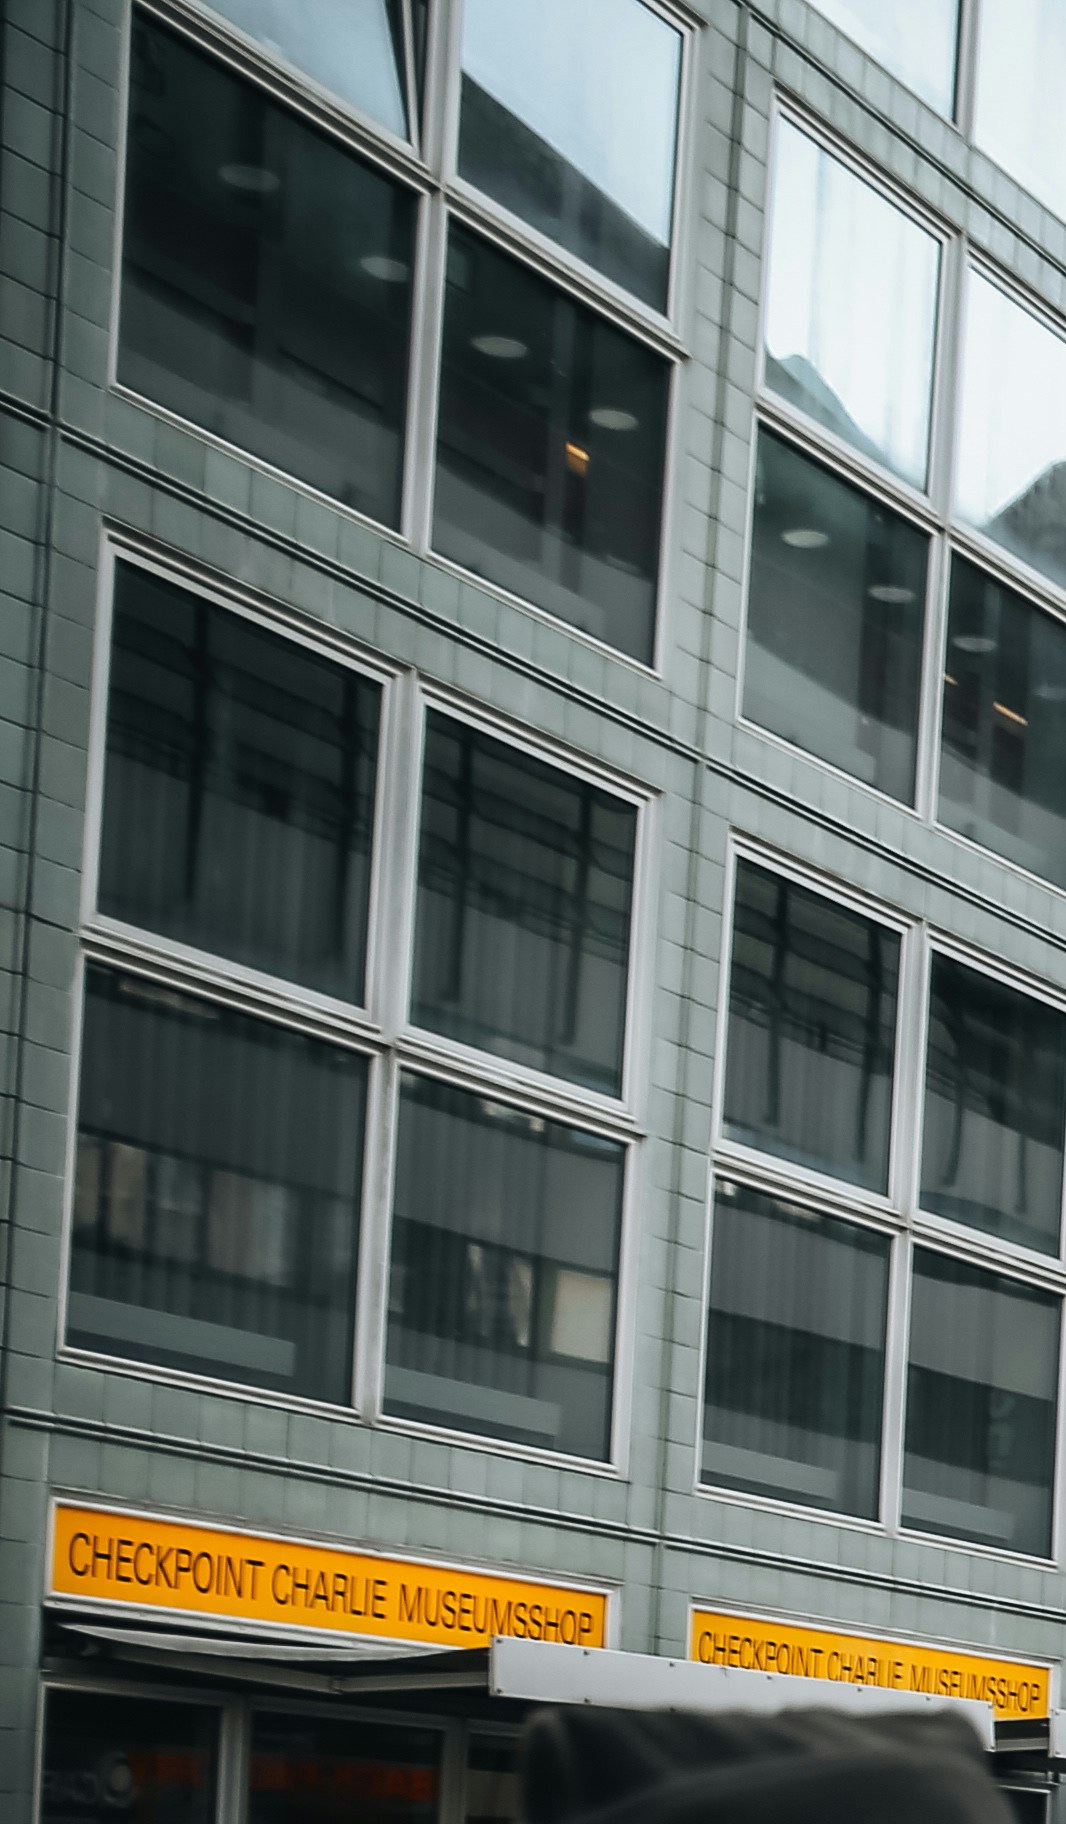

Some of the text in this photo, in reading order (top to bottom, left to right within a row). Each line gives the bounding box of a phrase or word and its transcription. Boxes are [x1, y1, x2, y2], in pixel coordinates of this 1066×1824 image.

[69, 1532, 593, 1646] CHECKPOINT CHARLIE MUSEUMSSHOP
[699, 1631, 824, 1678] CHECKPOINT
